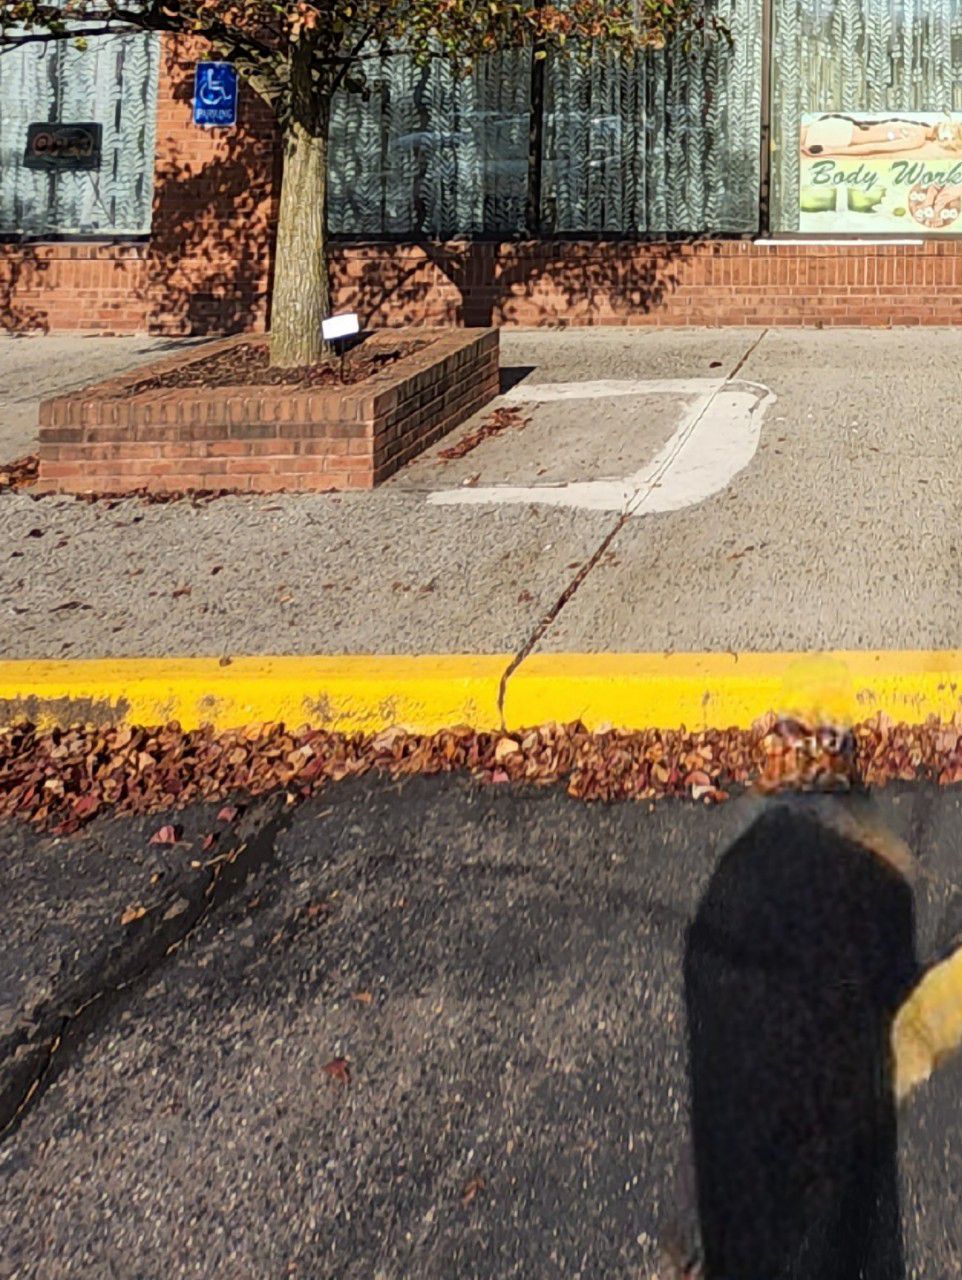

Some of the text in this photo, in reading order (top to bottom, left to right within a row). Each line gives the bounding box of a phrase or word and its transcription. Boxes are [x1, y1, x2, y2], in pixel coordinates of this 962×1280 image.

[196, 108, 233, 121] PARKING
[810, 159, 962, 192] Body Work
